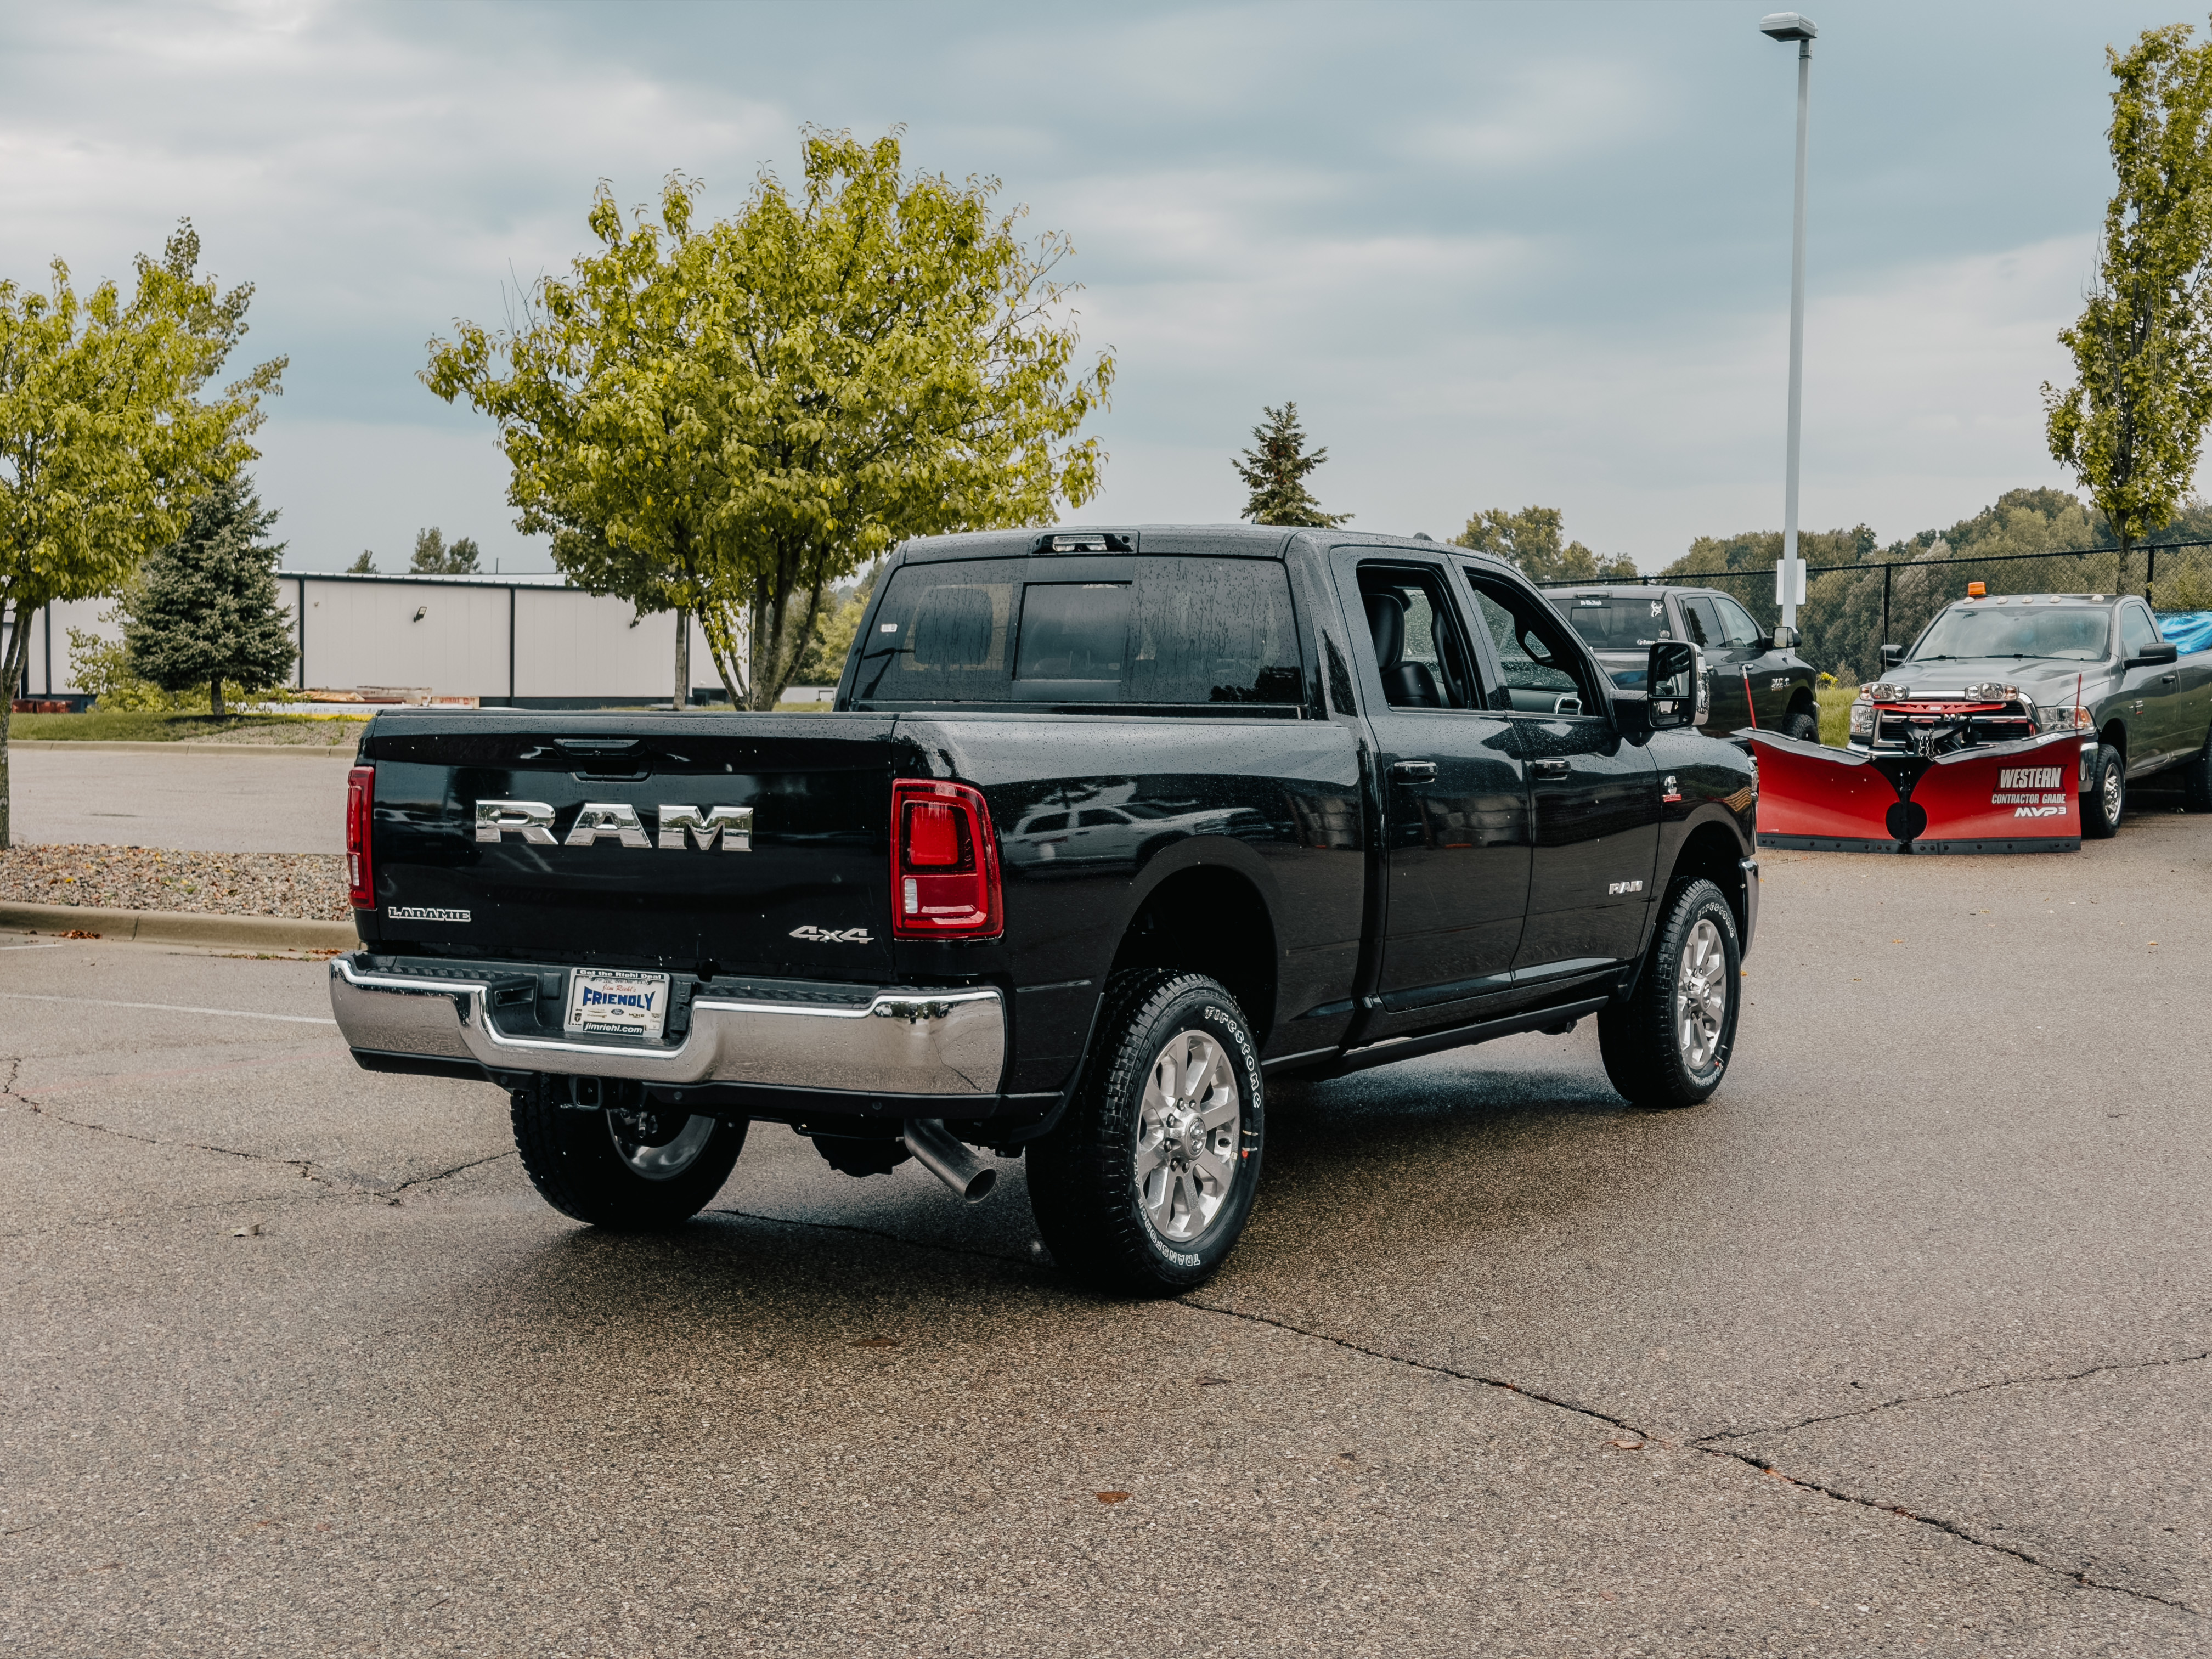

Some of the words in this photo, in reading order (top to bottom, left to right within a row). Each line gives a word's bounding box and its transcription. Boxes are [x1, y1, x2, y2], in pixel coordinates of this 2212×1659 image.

[2000, 767, 2062, 788] WESTERN
[1991, 793, 2040, 804] CONTRACTOR
[2042, 793, 2067, 804] GRADE
[2014, 806, 2067, 817] MVP3
[475, 799, 754, 852] RAM
[1609, 880, 1643, 895] RAM
[388, 906, 472, 922] LARAMIE
[788, 925, 874, 944] 4x4
[602, 984, 614, 992] Jim
[582, 986, 656, 1012] FRIENDLY
[584, 1022, 643, 1034] jimriehl.com
[1204, 1006, 1262, 1109] Firestone
